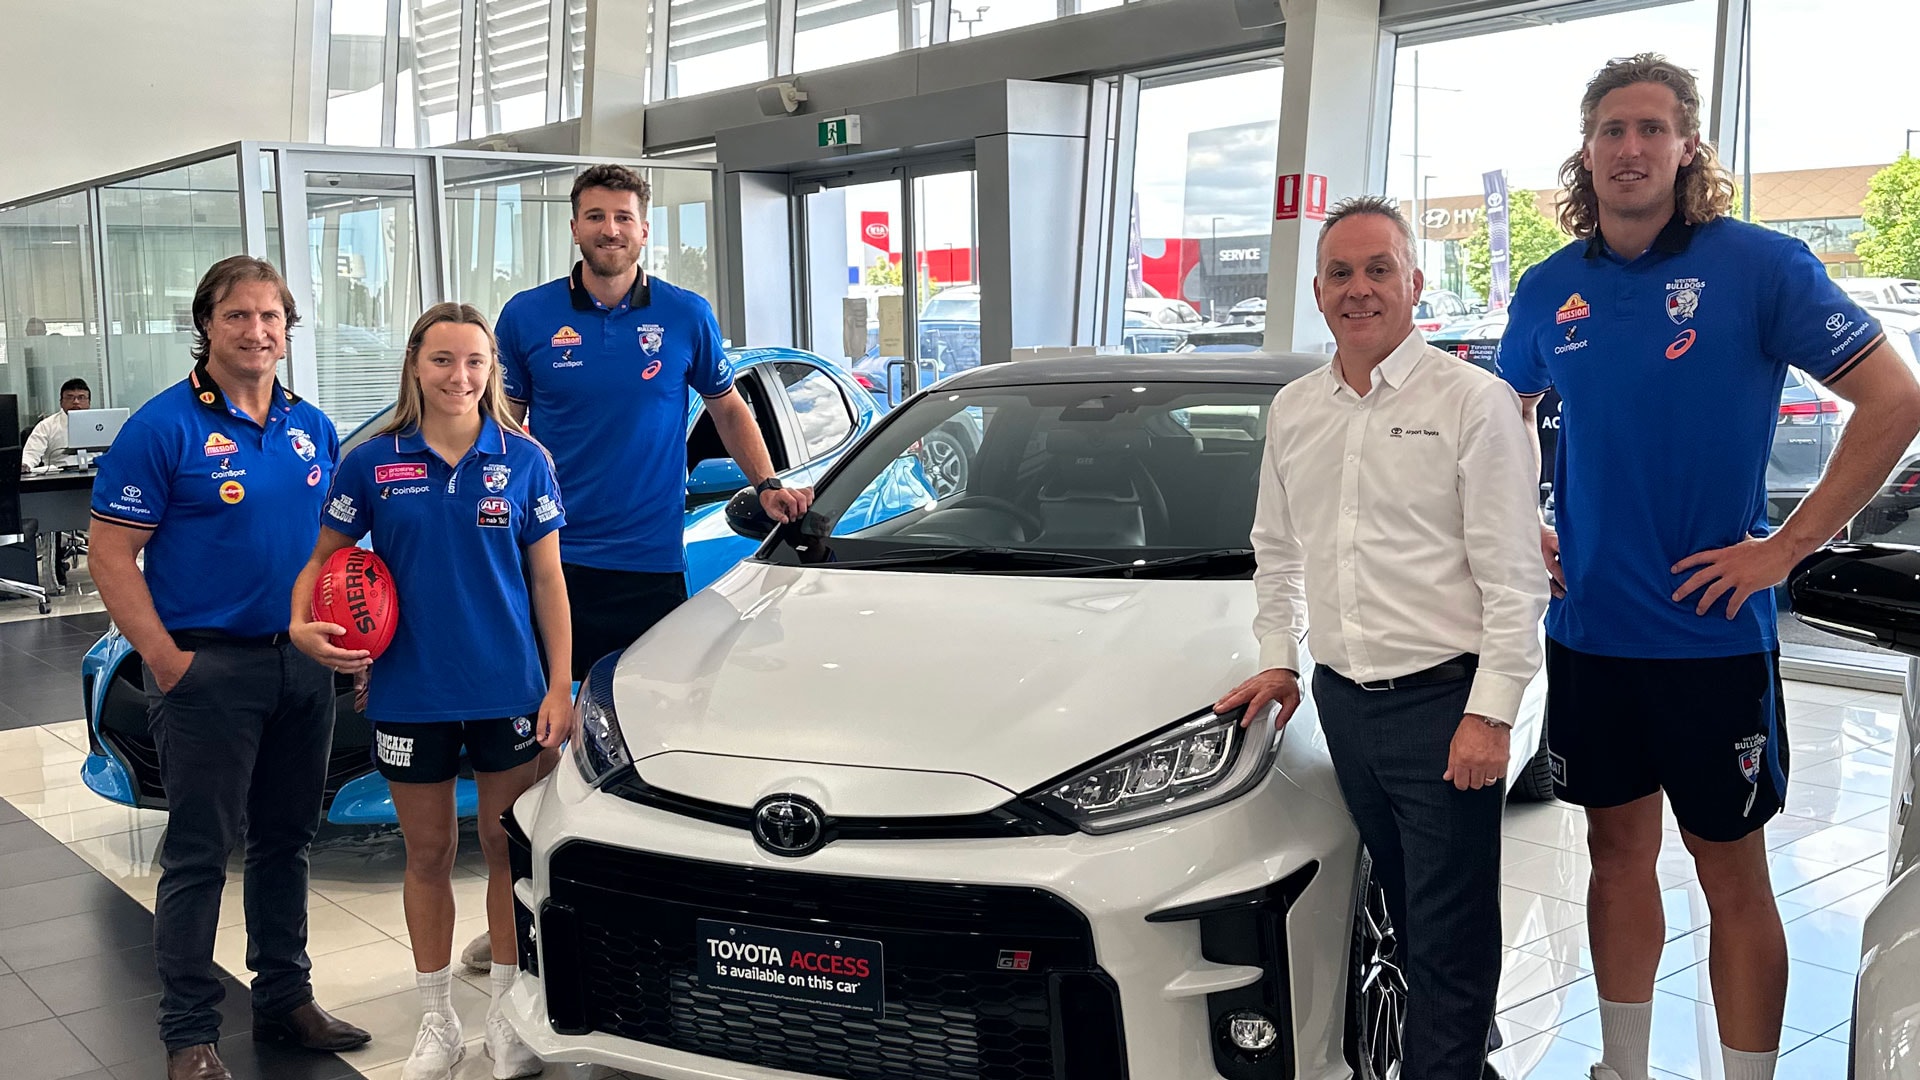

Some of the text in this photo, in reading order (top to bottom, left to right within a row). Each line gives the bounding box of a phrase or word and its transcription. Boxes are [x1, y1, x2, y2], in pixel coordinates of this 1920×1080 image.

[1219, 248, 1261, 262] SERVICE
[1665, 281, 1706, 290] BULLDOGS
[1832, 320, 1854, 339] TOYOTA
[1831, 322, 1870, 356] Airport Toyota
[1555, 340, 1588, 355] CoinSpot
[552, 360, 583, 368] CoinSpot
[211, 469, 247, 479] CoinSpot
[392, 485, 430, 495] CoinSpot
[120, 495, 142, 504] TOYOTA
[481, 500, 508, 511] AFL
[109, 502, 131, 512] Airport
[346, 548, 376, 634] SHERRIN
[376, 729, 414, 752] PANCAKE
[706, 938, 870, 978] TOYOTA ACCESS
[998, 957, 1029, 968] GR
[716, 962, 728, 976] is
[730, 966, 785, 984] available
[788, 974, 805, 987] on
[808, 975, 834, 991] this
